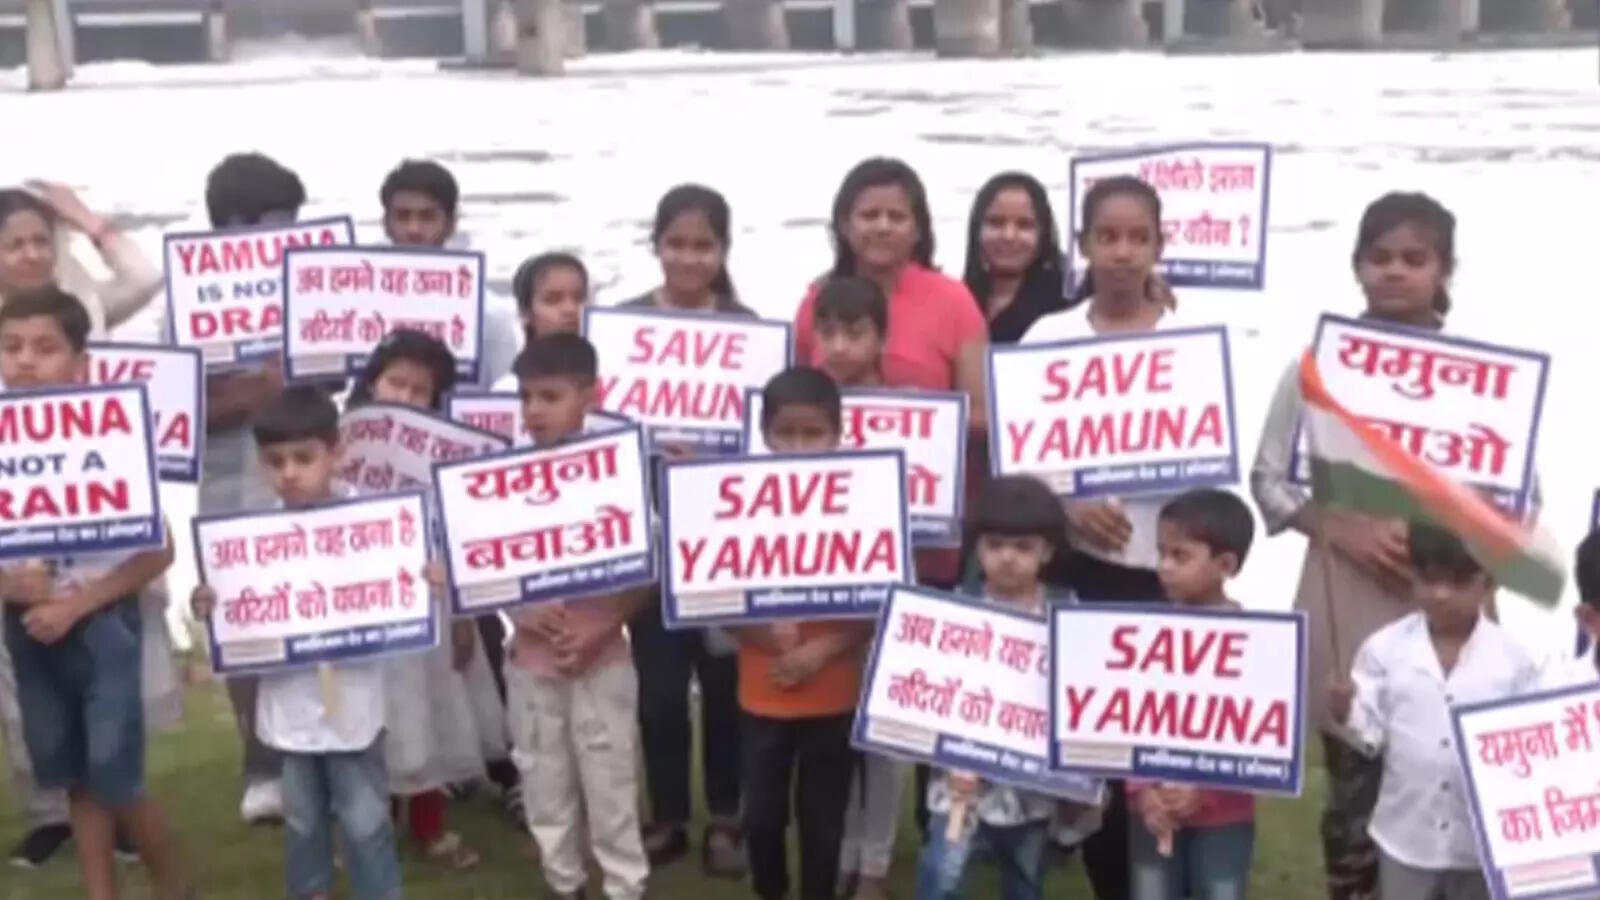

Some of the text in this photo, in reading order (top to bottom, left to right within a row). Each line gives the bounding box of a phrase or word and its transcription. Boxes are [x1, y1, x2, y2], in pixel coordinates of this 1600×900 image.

[197, 279, 276, 303] IS NO
[190, 304, 281, 339] DRA
[628, 327, 747, 369] SAVE
[1042, 349, 1175, 403] SAVE
[1338, 333, 1519, 399] यमुना
[594, 375, 743, 420] YAMUN
[1006, 402, 1223, 463] YAMUNA
[0, 450, 105, 477] NOT A
[462, 443, 620, 507] यमुना
[714, 471, 851, 520] SAVE
[462, 505, 633, 570] बचाओ
[678, 529, 897, 583] YAMUNA
[896, 612, 934, 648] अब
[937, 621, 994, 662] हमने
[1106, 625, 1249, 679] SAVE
[887, 668, 1048, 740] नदियों को बचा
[1065, 686, 1289, 746] YAMUNA
[1475, 721, 1559, 779] यमुना
[1561, 702, 1593, 751] में
[1497, 804, 1543, 842] का
